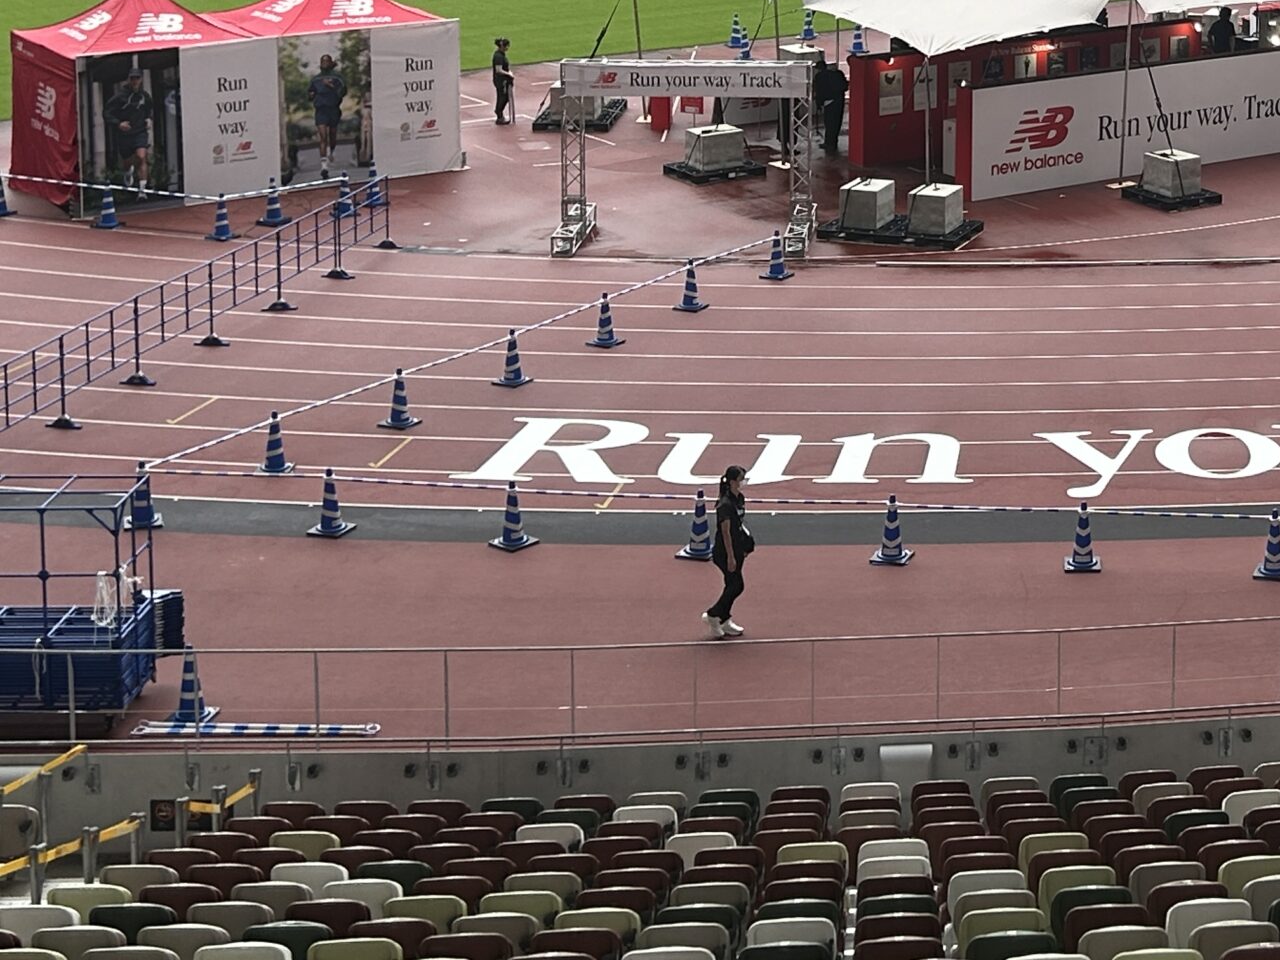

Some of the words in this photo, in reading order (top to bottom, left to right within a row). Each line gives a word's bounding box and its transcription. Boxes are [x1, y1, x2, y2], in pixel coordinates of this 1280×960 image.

[404, 57, 433, 72] Run
[217, 77, 248, 93] Run
[403, 79, 435, 98] your
[629, 72, 661, 88] Run
[665, 75, 700, 92] your
[740, 72, 782, 88] Track
[216, 99, 250, 119] your
[405, 100, 433, 116] way.
[218, 121, 248, 137] way.
[1005, 106, 1075, 153] NB
[1098, 115, 1140, 141] Run
[1147, 109, 1192, 142] your
[1196, 103, 1237, 131] way.
[991, 161, 1021, 176] new
[1024, 152, 1084, 171] balance
[448, 416, 974, 484] Run
